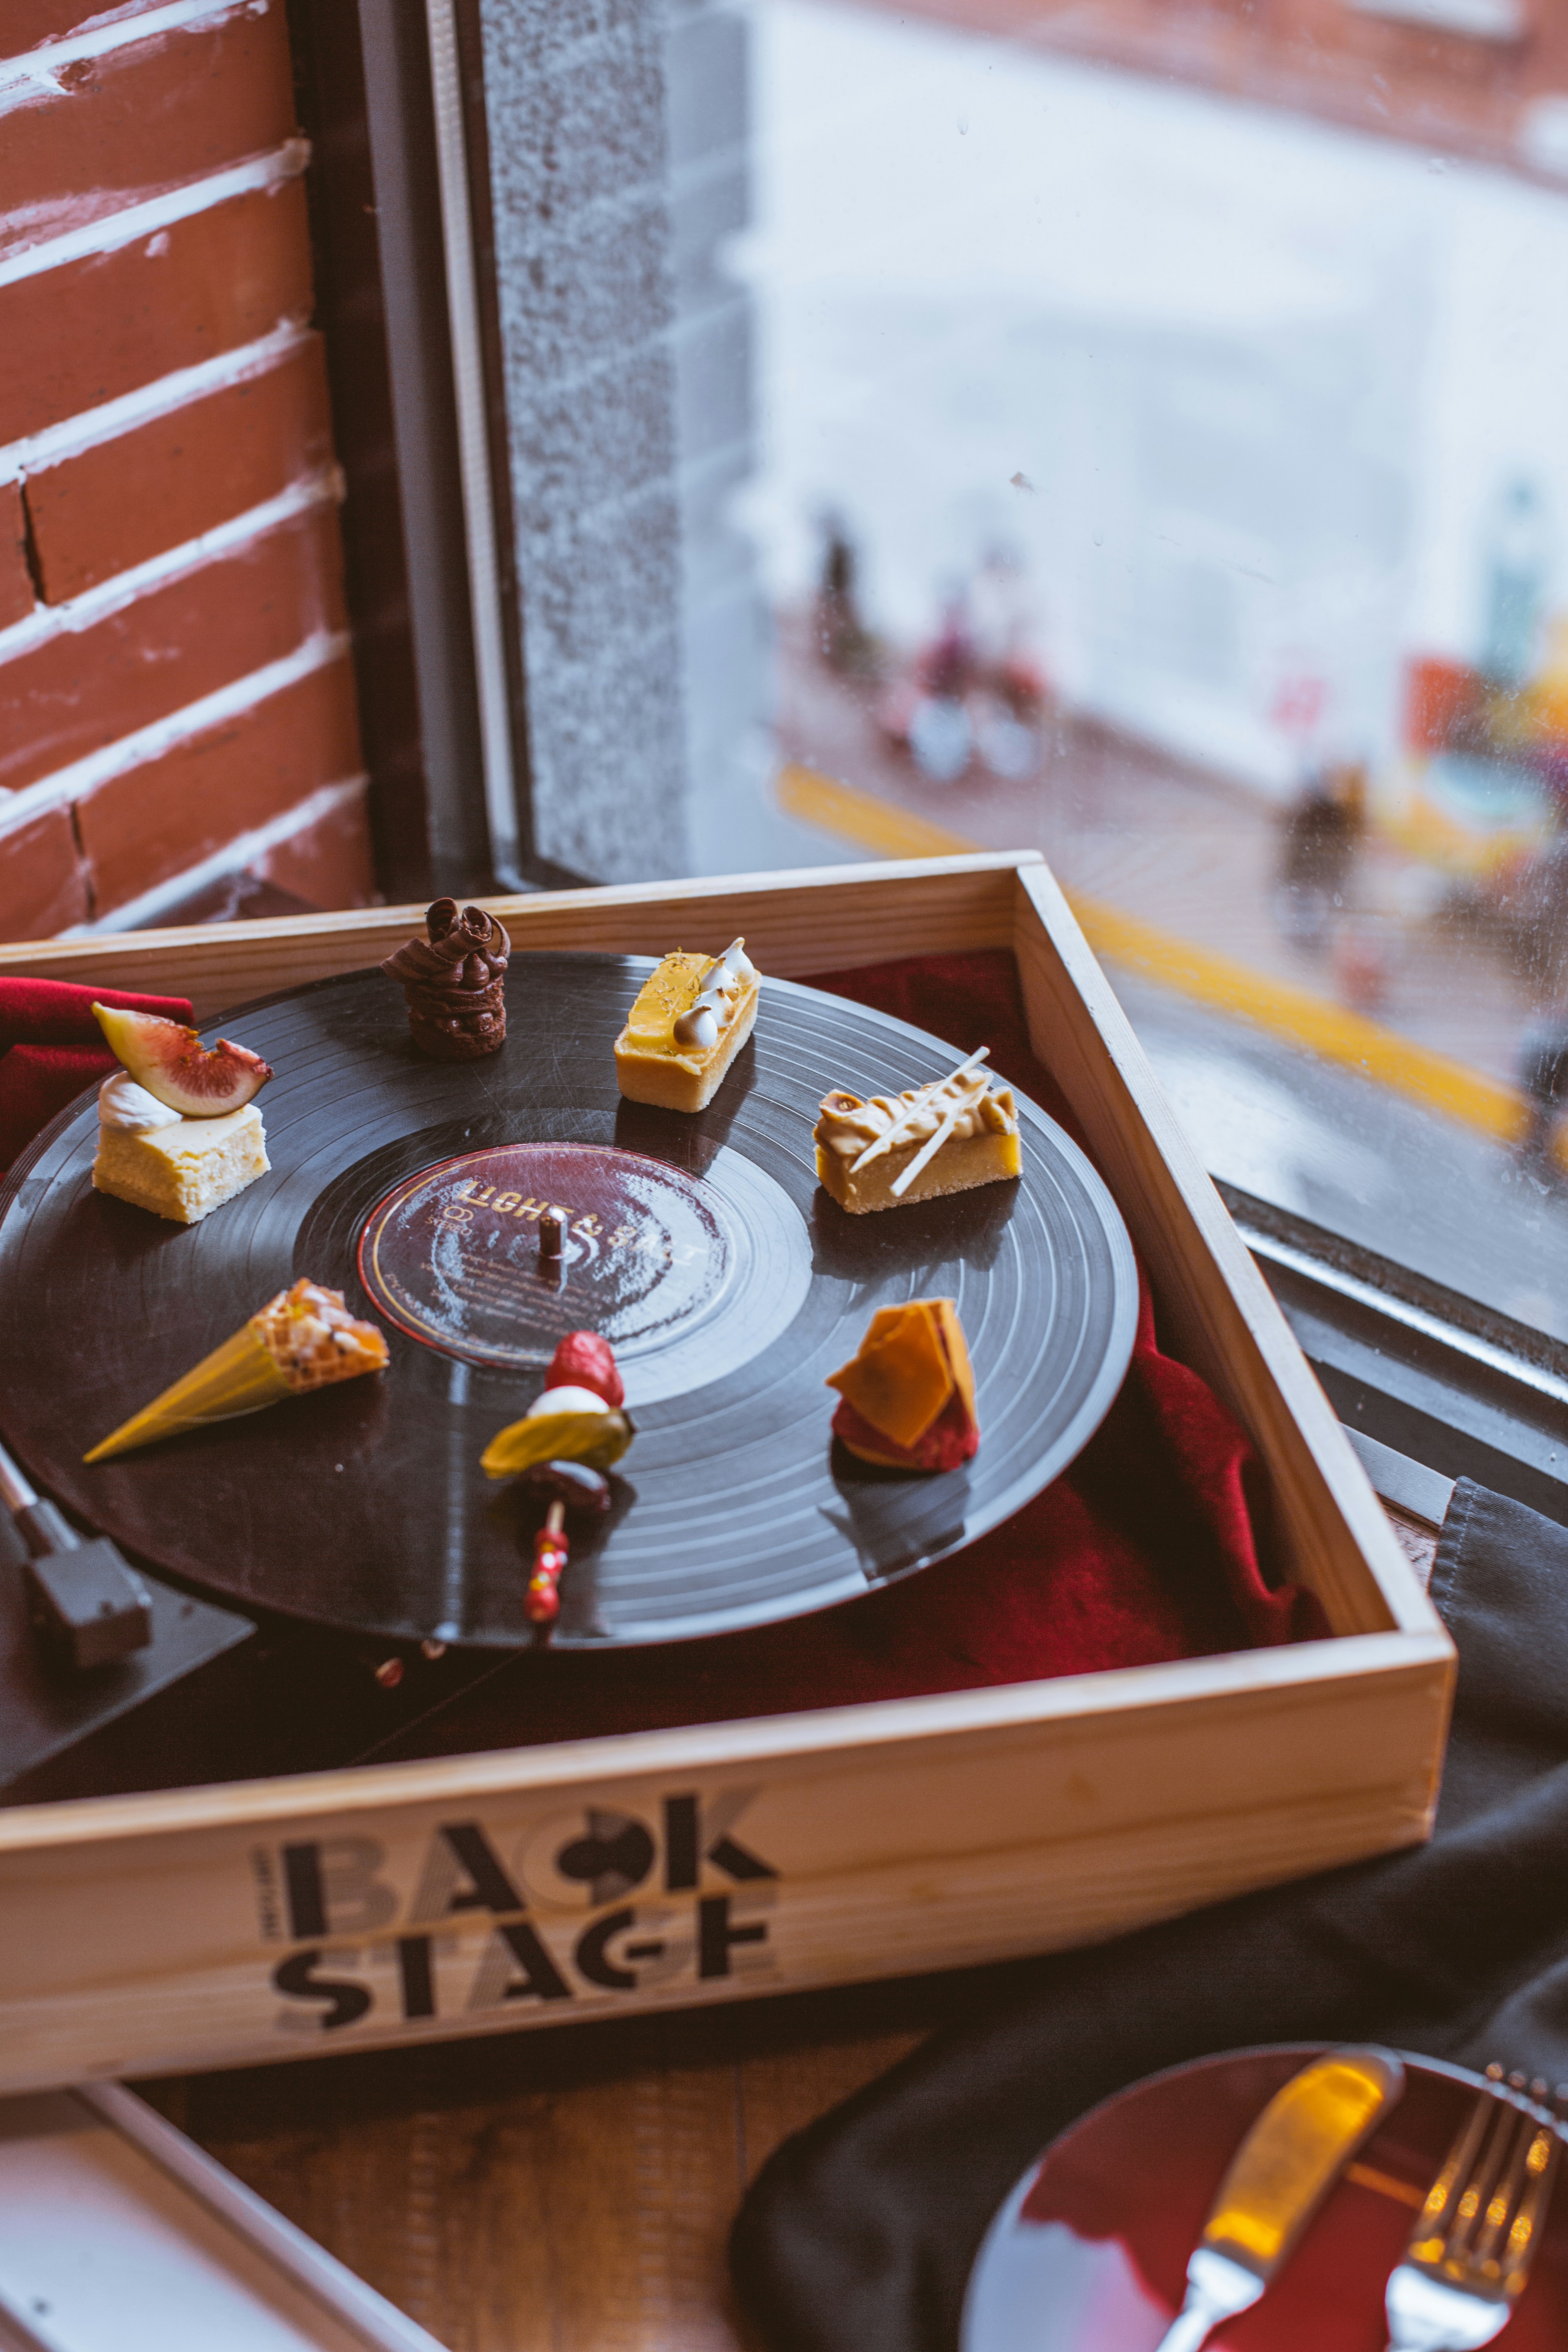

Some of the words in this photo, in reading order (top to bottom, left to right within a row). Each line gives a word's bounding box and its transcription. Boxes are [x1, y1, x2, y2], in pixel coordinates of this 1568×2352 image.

[425, 1216, 473, 1236] STEREO
[280, 1784, 779, 1943] BACK
[271, 1891, 778, 2033] STAGE
